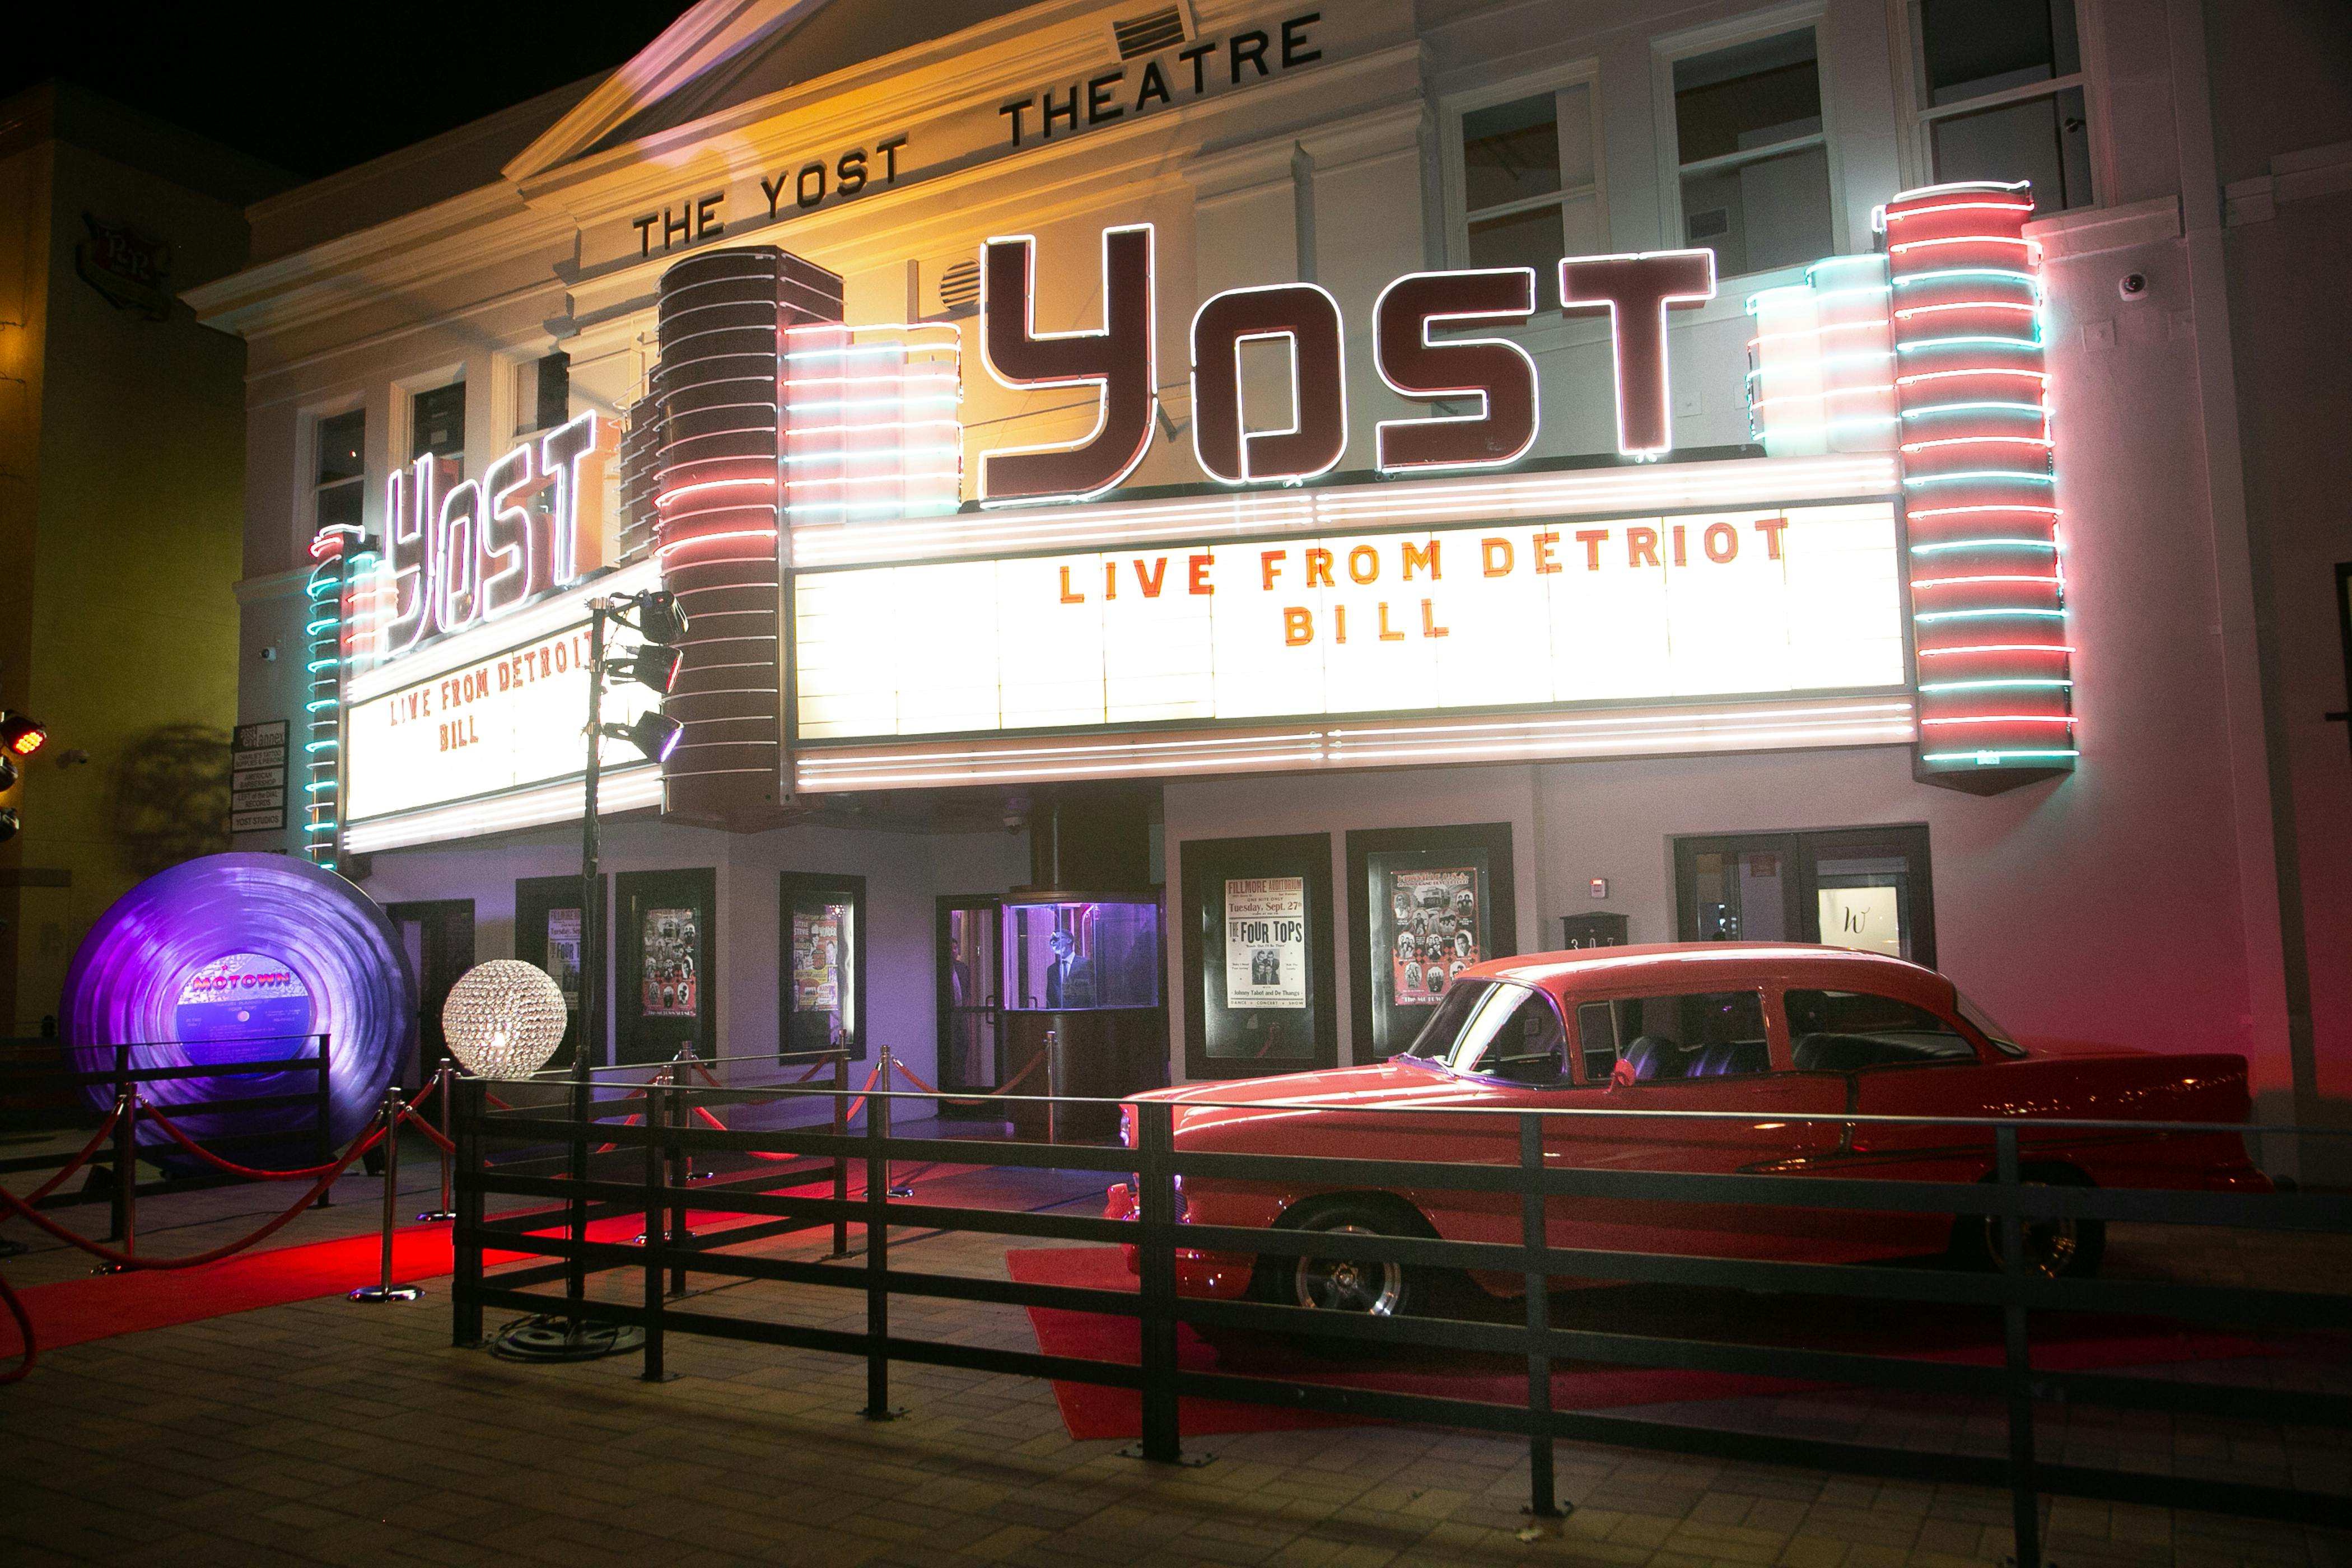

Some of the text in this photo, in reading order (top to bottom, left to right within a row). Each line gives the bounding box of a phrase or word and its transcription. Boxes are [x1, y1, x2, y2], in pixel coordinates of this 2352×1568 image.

[634, 11, 1323, 258] THE YOST THEATRE
[978, 223, 1717, 510] YOST
[382, 409, 597, 659] YOST
[1060, 517, 1789, 604] LIVE FROM DETRIOT
[1284, 598, 1449, 647] BILL
[390, 688, 431, 726] LIVE
[441, 668, 489, 711] FROM
[258, 732, 284, 746] annex
[439, 715, 479, 752] BILL
[237, 792, 251, 801] LEFT
[245, 799, 271, 808] RECORDS
[236, 815, 279, 826] YOST STUDIOS
[1229, 879, 1302, 894] FILLMORE AUDITORIUM
[1266, 902, 1285, 912] Sept.
[1229, 921, 1302, 944] THE FOUR TOPS
[557, 942, 574, 959] FOUR
[193, 972, 291, 991] MOTOWN
